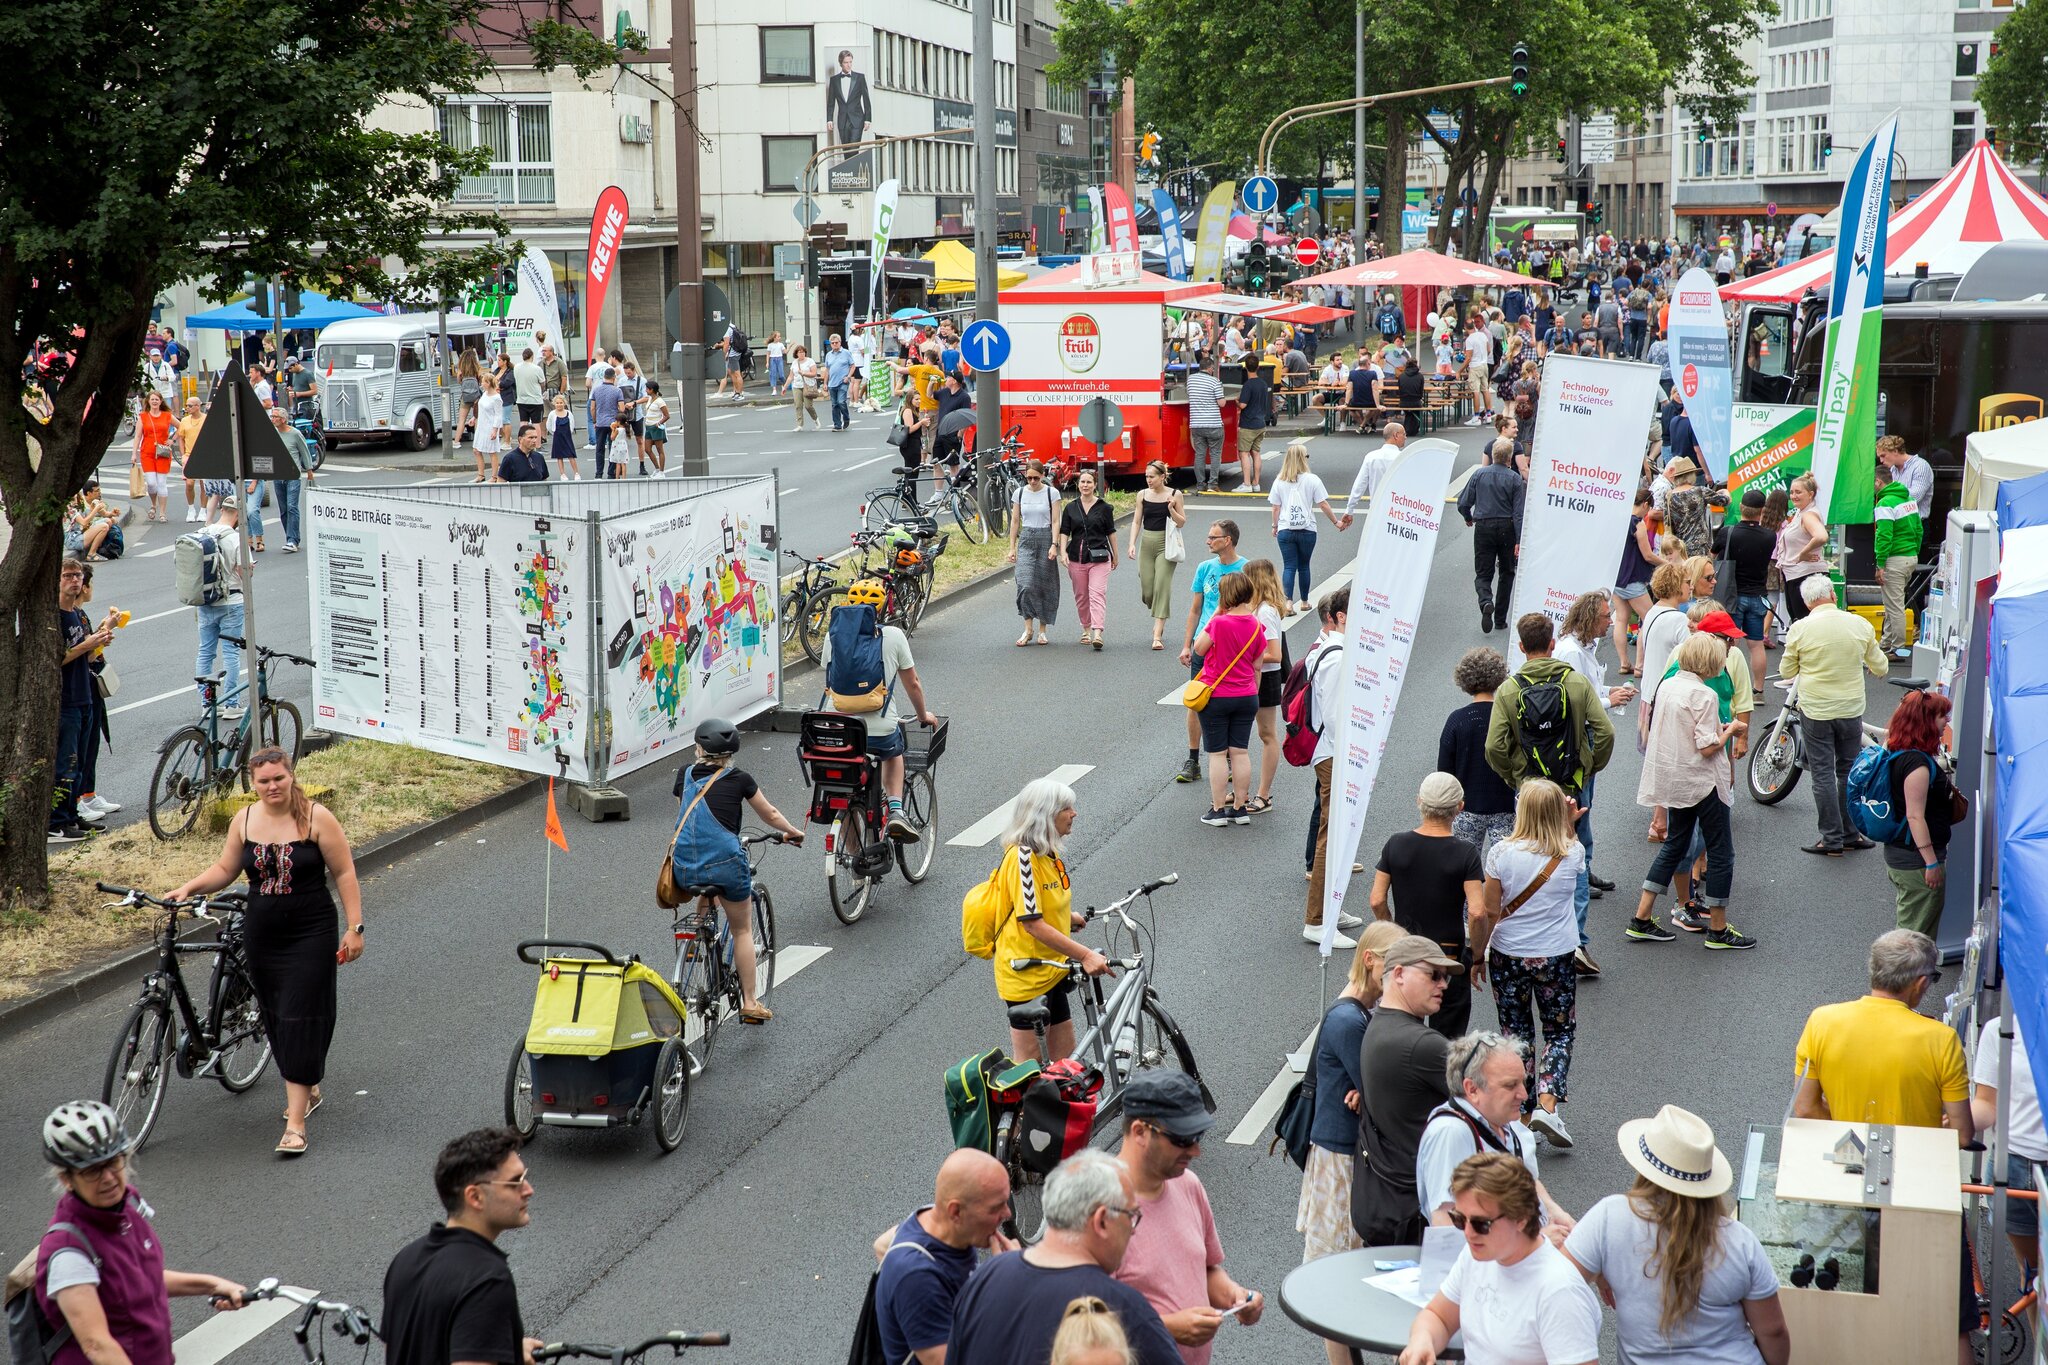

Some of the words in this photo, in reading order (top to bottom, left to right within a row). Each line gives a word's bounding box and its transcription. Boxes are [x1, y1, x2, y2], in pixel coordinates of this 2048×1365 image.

[1058, 124, 1074, 146] BRAX
[1861, 156, 1881, 252] WIRTSCHAFTSDIENST
[1873, 181, 1883, 213] LOGISTIK
[590, 204, 625, 282] REWE
[1065, 338, 1093, 354] früh
[1048, 381, 1110, 391] www.frueh.de
[1562, 380, 1610, 396] Technology
[1026, 393, 1061, 402] CÖLNER
[1110, 393, 1133, 402] FRÜH
[1560, 391, 1577, 402] Arts
[1578, 394, 1614, 406] Sciences
[1559, 402, 1571, 412] TH
[1573, 404, 1592, 416] Köln
[1733, 438, 1768, 467] MAKE
[1737, 438, 1798, 482] TRUCKING
[1551, 459, 1622, 485] Technology
[1743, 466, 1782, 493] GREAT
[1548, 476, 1574, 491] Arts
[1577, 480, 1626, 501] Sciences
[1391, 492, 1434, 517] Technology
[1547, 493, 1565, 508] TH
[1568, 497, 1595, 514] Köln
[1903, 502, 1916, 513] TEAM
[351, 509, 392, 525] BEITRÄGE
[395, 514, 423, 522] STRASSENLAND
[1388, 506, 1404, 521] Arts
[1406, 510, 1439, 532] Sciences
[447, 517, 490, 543] strassen
[1387, 522, 1398, 535] TH
[1399, 525, 1418, 542] Köln
[462, 538, 486, 558] land
[1365, 588, 1389, 601] Technology
[1364, 596, 1373, 604] Arts
[1374, 598, 1391, 609] Sciences
[1364, 603, 1370, 611] TH
[1370, 605, 1380, 614] Köln
[1544, 598, 1559, 609] Arts
[1543, 609, 1554, 619] TH
[615, 630, 628, 651] NORD
[1360, 635, 1368, 643] Arts
[1361, 626, 1384, 640] Technology
[687, 633, 700, 655] TUNNEL
[1359, 642, 1366, 650] TH
[1366, 644, 1375, 653] Köln
[1356, 664, 1379, 678] Technology
[1355, 672, 1364, 680] Arts
[1365, 675, 1381, 686] Sciences
[1362, 682, 1371, 691] Köln
[320, 706, 335, 716] REWE
[1352, 704, 1375, 718] Technology
[1351, 720, 1358, 729] TH
[1358, 722, 1367, 732] Köln
[546, 1027, 597, 1037] CROOZER
